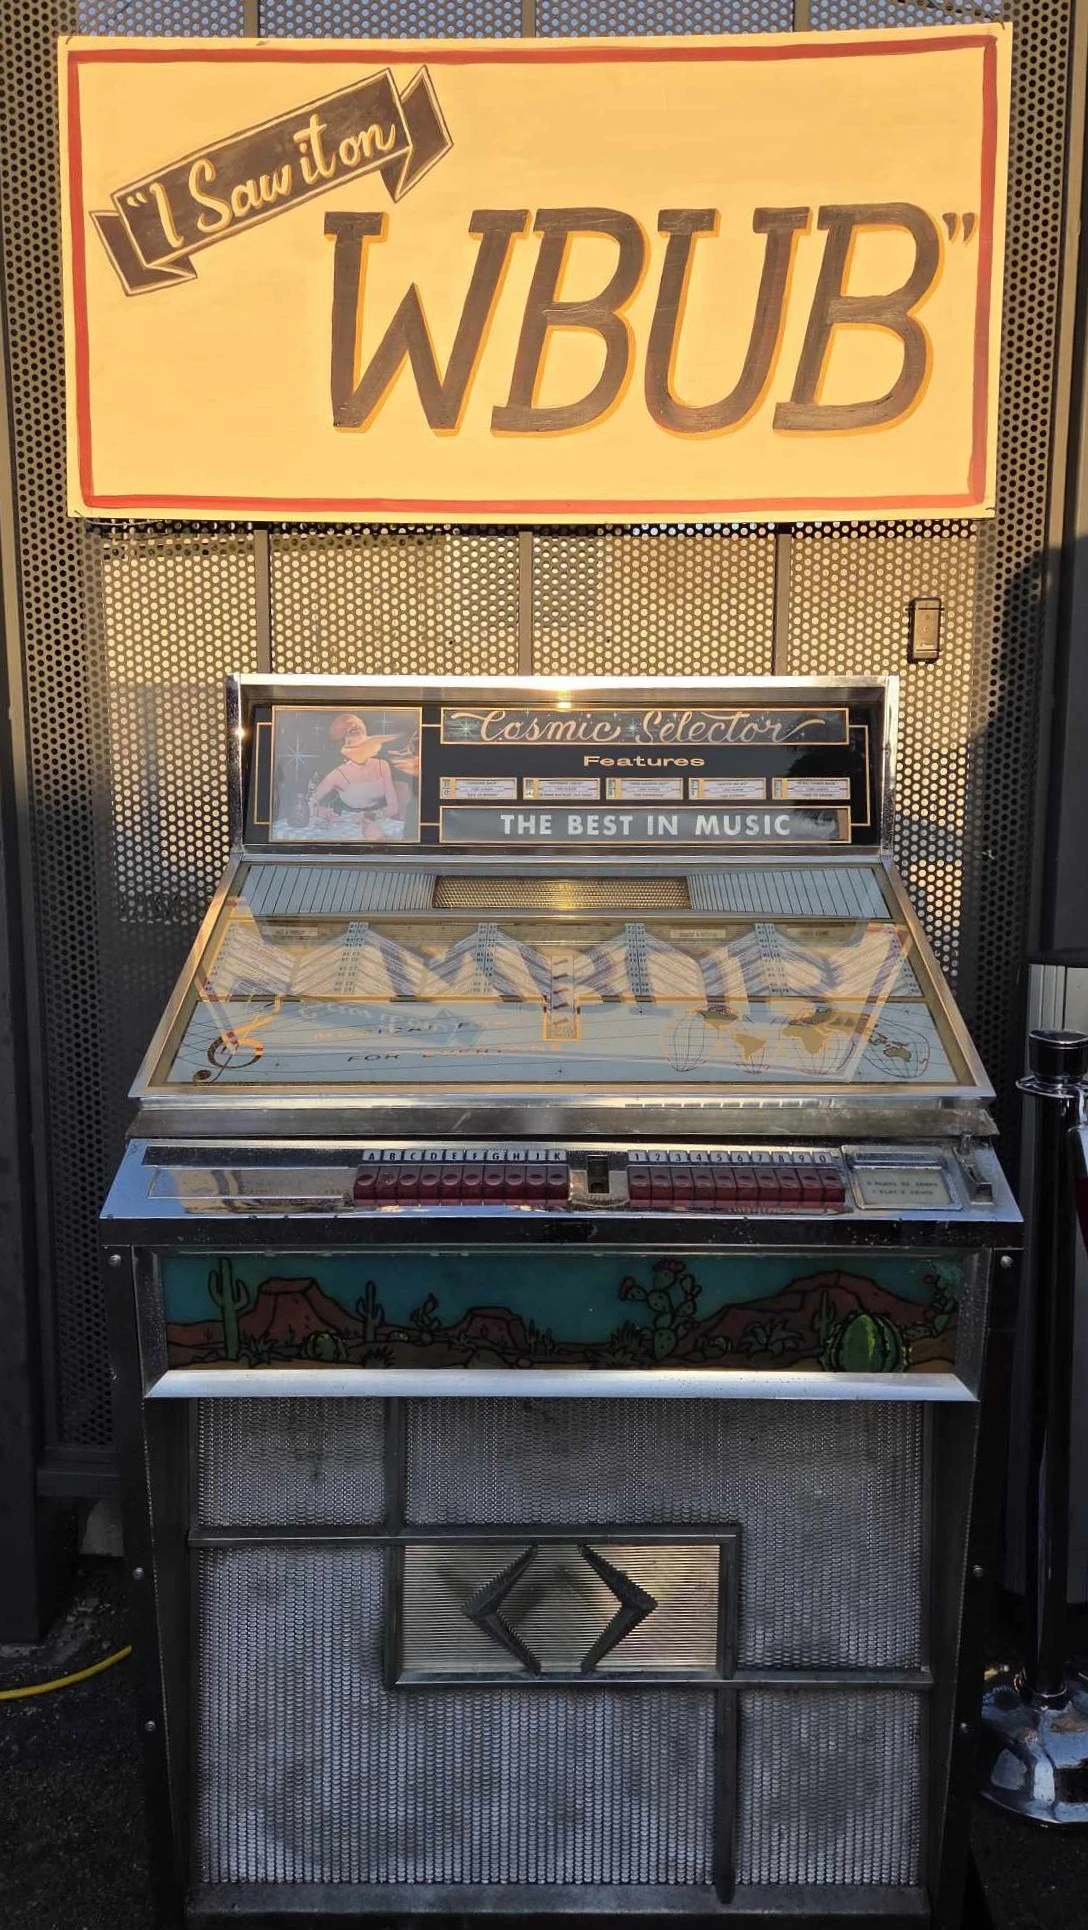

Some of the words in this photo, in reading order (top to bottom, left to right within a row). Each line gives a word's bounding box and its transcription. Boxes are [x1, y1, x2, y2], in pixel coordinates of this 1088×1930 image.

[188, 158, 293, 234] Saw
[293, 113, 336, 185] it
[339, 123, 396, 167] on
[451, 710, 621, 742] Cosmic
[635, 710, 826, 743] Selector
[583, 755, 705, 767] Features
[500, 814, 552, 835] THE
[567, 814, 633, 836] BEST
[647, 814, 678, 836] IN
[695, 814, 791, 836] MUSIC
